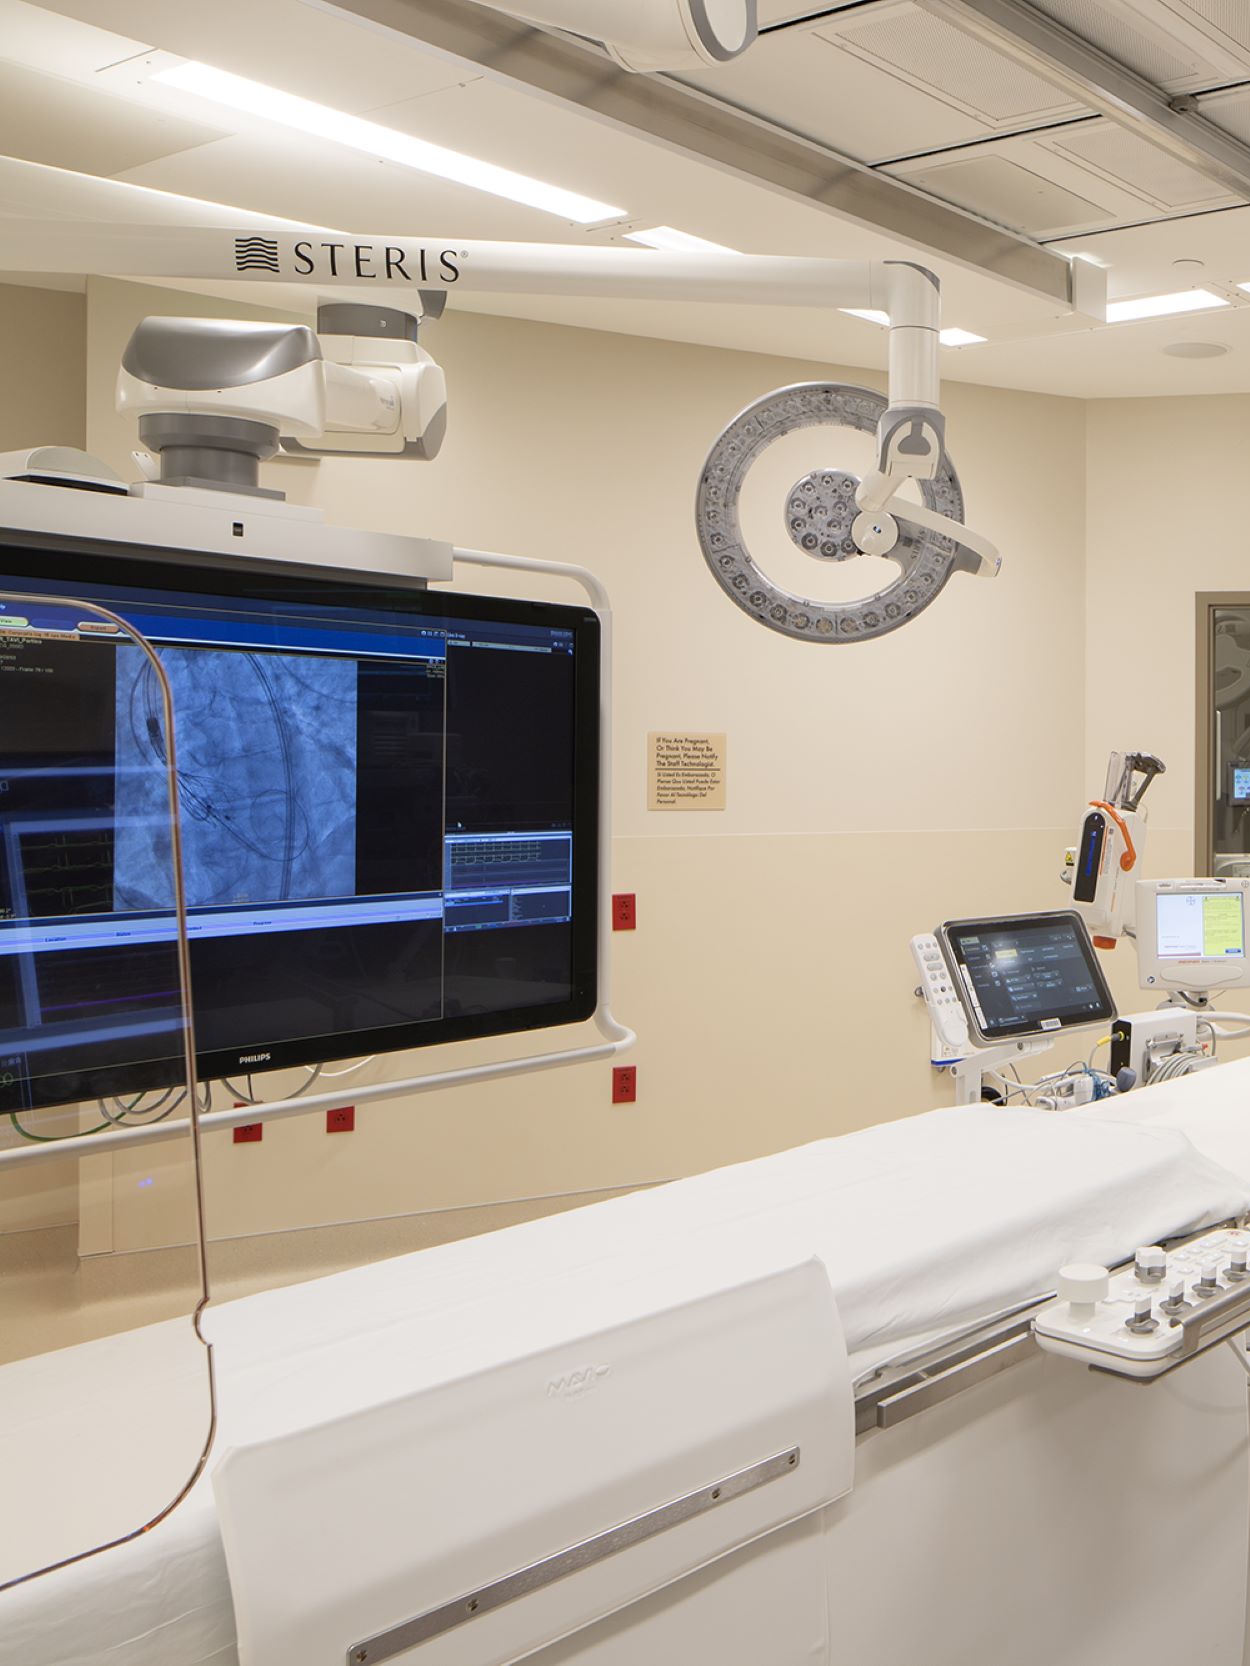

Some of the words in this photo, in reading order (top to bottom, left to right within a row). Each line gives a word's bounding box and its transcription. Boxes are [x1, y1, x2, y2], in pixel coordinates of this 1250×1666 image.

[294, 241, 460, 283] STERIS
[702, 753, 718, 761] Notify
[239, 1053, 271, 1065] PHILIPS
